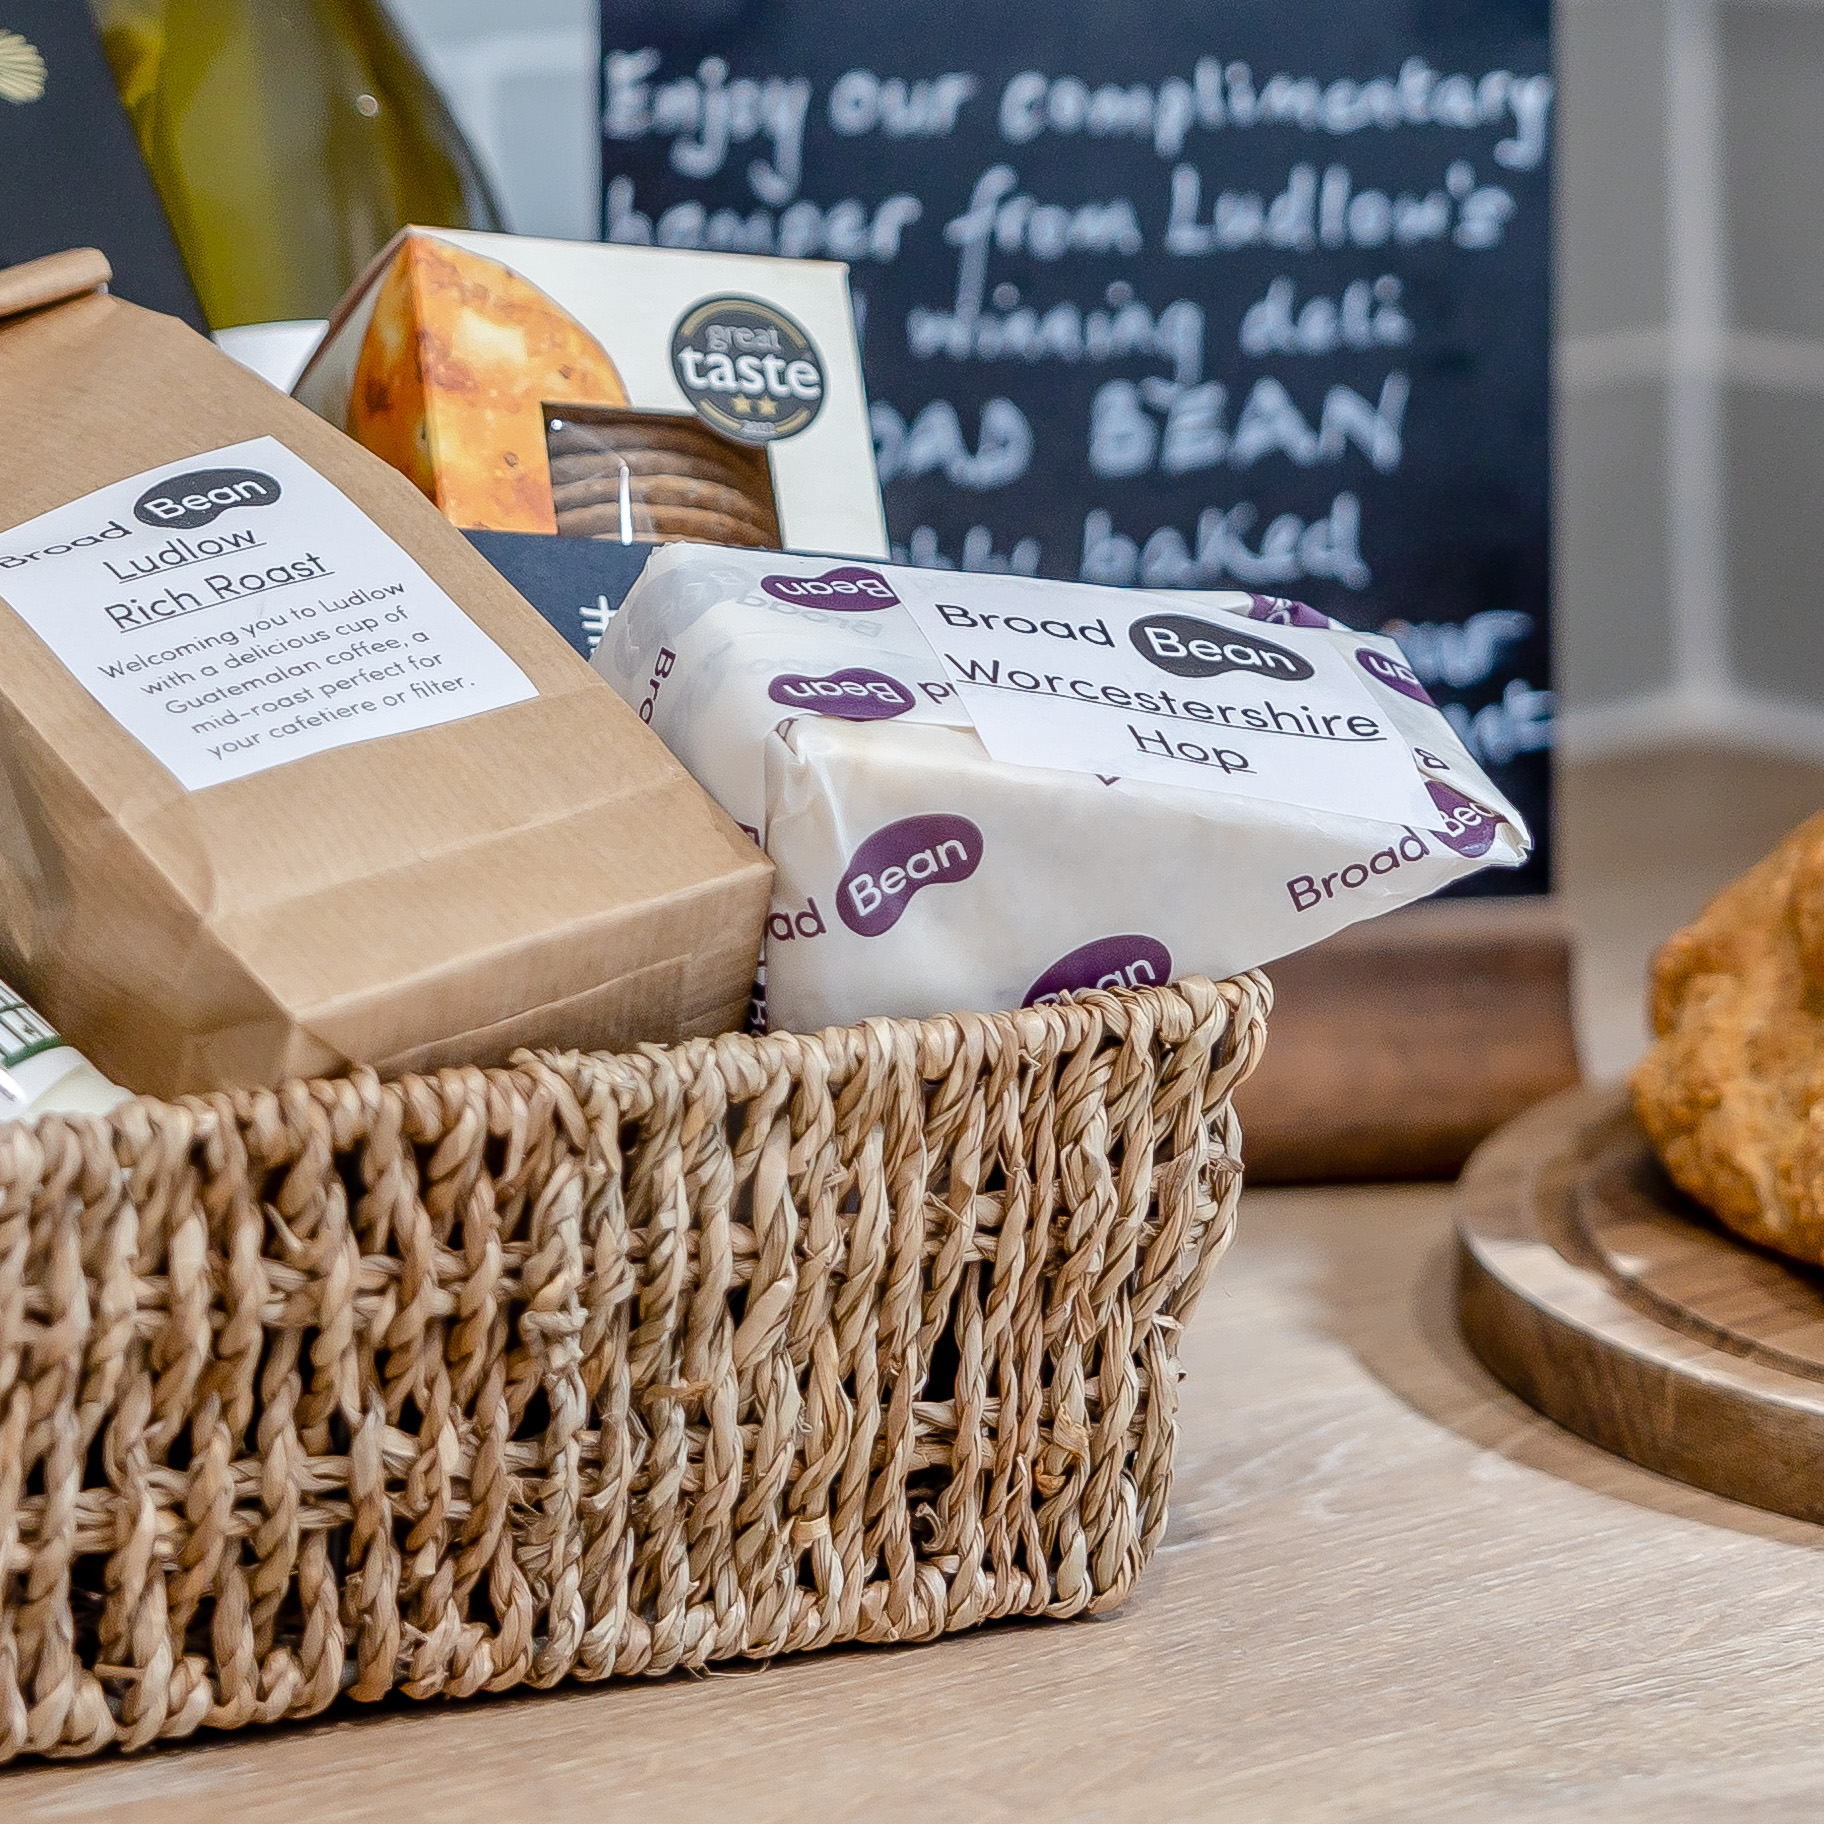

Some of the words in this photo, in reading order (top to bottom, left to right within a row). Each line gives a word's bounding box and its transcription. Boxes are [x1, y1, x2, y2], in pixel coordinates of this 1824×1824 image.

[603, 49, 810, 203] Enjoy
[828, 67, 972, 139] our
[998, 56, 1553, 172] complimentary
[945, 165, 1142, 336] from
[1166, 163, 1517, 258] Ludlow's
[1240, 275, 1414, 358] deli
[678, 346, 822, 401] taste
[1087, 372, 1410, 476] BEAN
[144, 479, 268, 520] Bean
[1083, 491, 1370, 590] baked
[103, 529, 257, 581] Ludlow
[104, 588, 203, 630] Rich
[204, 552, 329, 599] Roast
[774, 578, 895, 600] Bean
[97, 629, 239, 679] Welcoming
[240, 614, 288, 638] you
[291, 606, 317, 620] to
[321, 582, 405, 613] Ludlow
[140, 667, 196, 696] with
[200, 663, 219, 677] a
[223, 627, 331, 669] delicious
[334, 618, 379, 637] cup
[383, 605, 409, 624] of
[164, 658, 322, 714] Guatemalan
[324, 639, 409, 666] coffee,
[415, 630, 430, 643] a
[935, 604, 1115, 648] Broad
[1143, 626, 1299, 674] Bean
[192, 687, 316, 734] mid-roast
[319, 661, 405, 699] perfect
[407, 651, 443, 674] for
[206, 730, 264, 760] your
[268, 697, 377, 738] cafetiere
[382, 691, 406, 707] or
[409, 674, 476, 699] filter.
[640, 647, 676, 724] Bro
[782, 680, 908, 704] Bean
[945, 653, 1381, 738] Worcestershire
[1127, 724, 1250, 773] Hop
[849, 836, 968, 917] Bean
[1287, 827, 1430, 912] Broad
